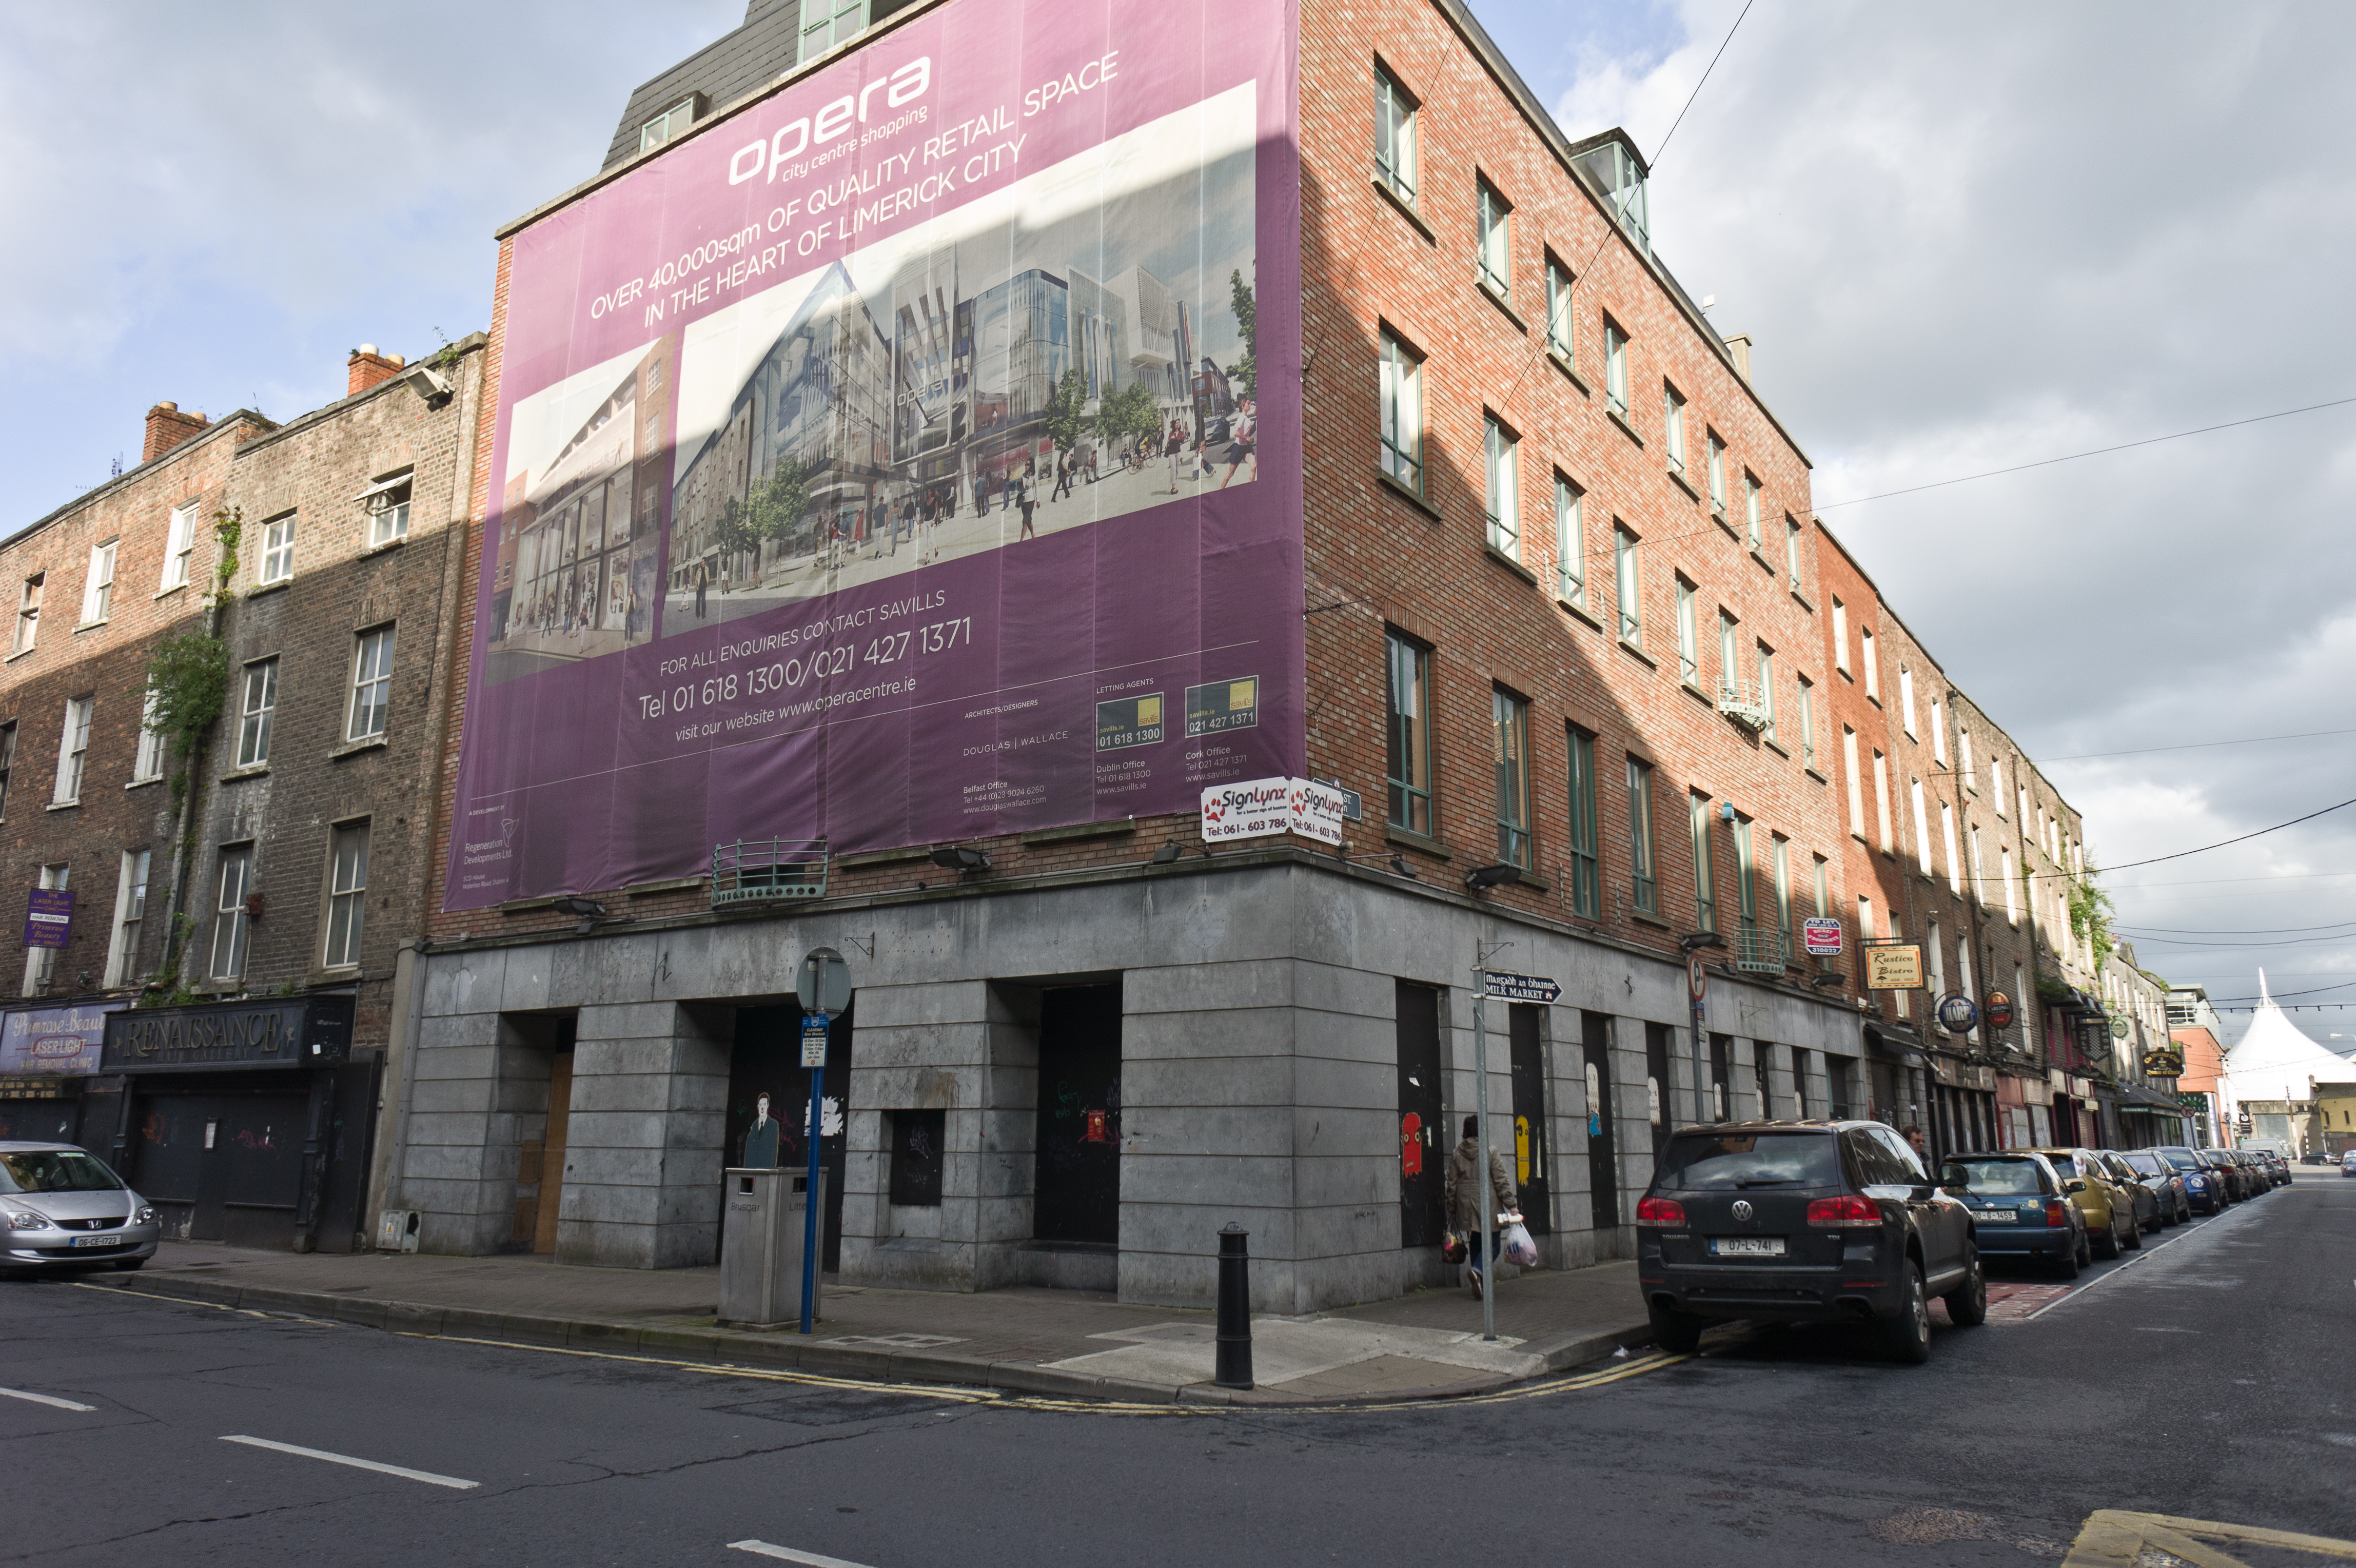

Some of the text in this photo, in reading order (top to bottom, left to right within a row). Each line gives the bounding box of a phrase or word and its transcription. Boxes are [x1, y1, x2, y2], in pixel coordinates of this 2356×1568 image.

[729, 55, 931, 186] opera
[782, 105, 928, 183] city centre shopping
[591, 50, 1120, 320] OVER 40,000sqm OF QUALITY RETAIL SPACE
[644, 133, 1027, 328] IN THE HEART OF LIMERICK CITY
[897, 380, 943, 407] opera
[634, 545, 657, 558] Signage
[660, 590, 945, 677] FOR ALL ENQUIRIES CONTACT SAVILLS
[639, 616, 972, 720] Tel 01 618 1300/021 427 1371
[1096, 678, 1154, 694] LETTING AGENTS
[675, 676, 916, 742] visit our website www.operacentre.ie
[965, 699, 1038, 719] ARCHITECTS/DESIGNERS
[1231, 698, 1252, 709] savills
[1139, 714, 1159, 725] savills
[1189, 709, 1215, 718] savills.ie
[1100, 724, 1124, 733] savills.ie
[1189, 711, 1253, 733] 021 427 1371
[963, 731, 1068, 756] DOUGLAS WALLACE
[1100, 728, 1160, 747] 01 618 1300
[1186, 747, 1230, 760] Cork Office
[1096, 760, 1145, 773] Dublin Office
[1186, 754, 1247, 771] Tel 021 427 1371
[1096, 775, 1107, 783] Tel
[1118, 772, 1131, 780] 618
[1133, 769, 1151, 779] 1300
[1186, 768, 1240, 782] www.savills.ie
[963, 781, 1008, 794] Belfast Office
[963, 796, 972, 804] Tel
[988, 791, 1006, 801] (0)28
[1007, 788, 1025, 797] 9024
[1027, 785, 1045, 795] 6260
[1096, 781, 1147, 795] www.savills.ie
[963, 796, 1047, 814] www.douglaswallace.com
[1221, 786, 1287, 810] SignLynx
[1303, 787, 1343, 815] SignLynx
[473, 806, 500, 816] DEVELOPMENT
[1206, 826, 1222, 837] Tel:
[1248, 820, 1265, 832] 603
[1268, 817, 1287, 829] 786
[1291, 817, 1303, 830] Tel:
[1319, 826, 1330, 837] 603
[1331, 829, 1341, 841] 786
[465, 839, 503, 853] Regeneration
[464, 849, 513, 865] Developments Ltd.
[31, 922, 65, 932] Primrose
[34, 930, 61, 940] Beauty
[1873, 952, 1913, 965] Rustico
[1877, 967, 1913, 975] Bistro
[1486, 984, 1543, 999] MILK MARKET
[66, 1008, 106, 1033] Beaut
[1945, 1006, 1970, 1022] HARP
[124, 1013, 282, 1057] RENAISSANCE
[30, 1038, 87, 1055] LASER LIGHT
[156, 1047, 249, 1063] HAIR GALLERY
[21, 1057, 92, 1070] HAIR REMOVAL CLINIC
[731, 1202, 807, 1211] Bruscar Litte
[78, 1237, 117, 1246] 06-CE-1723
[1729, 1238, 1771, 1251] 07-L-741
